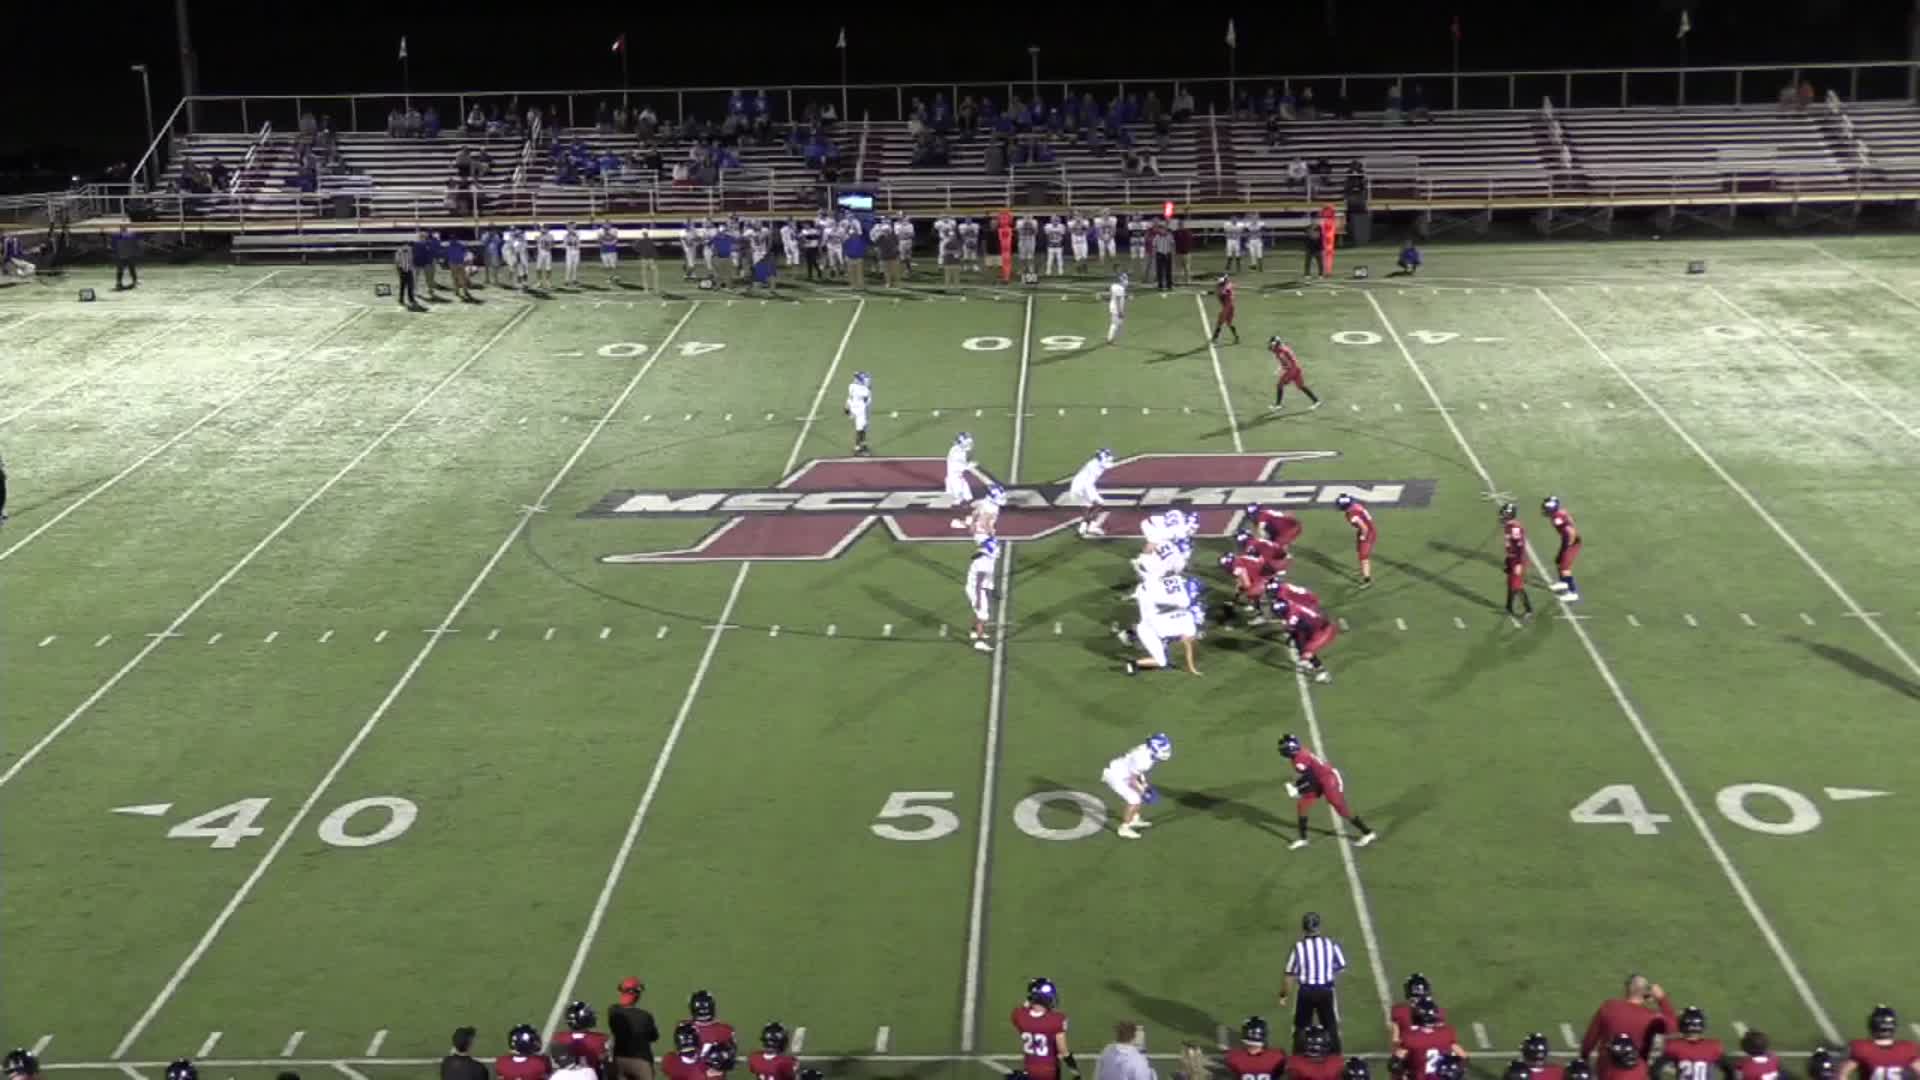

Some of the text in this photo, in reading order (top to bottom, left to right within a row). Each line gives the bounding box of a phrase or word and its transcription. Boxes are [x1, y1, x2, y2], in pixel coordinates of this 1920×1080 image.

[165, 797, 419, 848] 40
[869, 791, 1108, 841] 50
[1569, 783, 1823, 835] 40
[1021, 1031, 1049, 1057] 23
